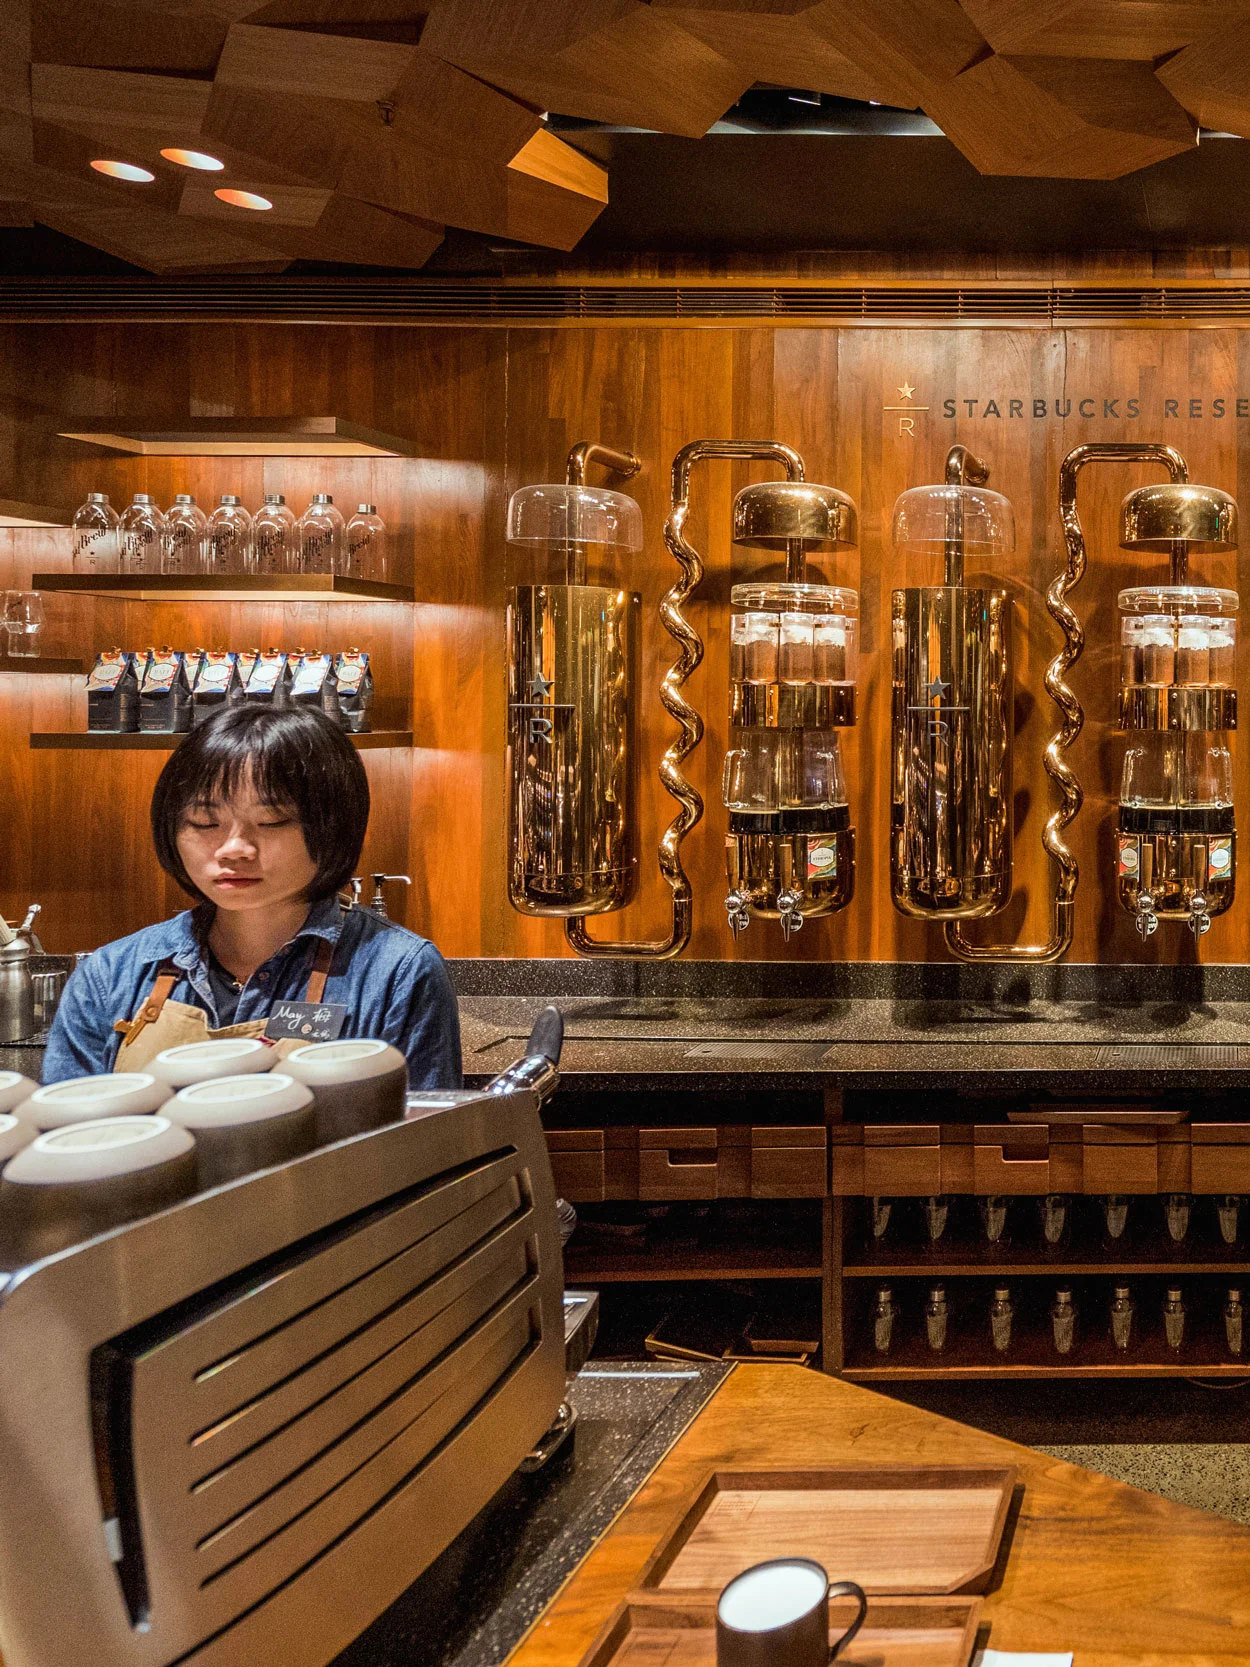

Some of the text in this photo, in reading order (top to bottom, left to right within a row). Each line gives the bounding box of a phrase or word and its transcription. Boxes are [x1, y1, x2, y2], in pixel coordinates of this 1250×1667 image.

[943, 398, 1140, 419] STARBUCKS
[899, 417, 915, 437] R
[530, 718, 554, 744] R
[928, 720, 949, 747] R
[272, 1005, 305, 1030] May
